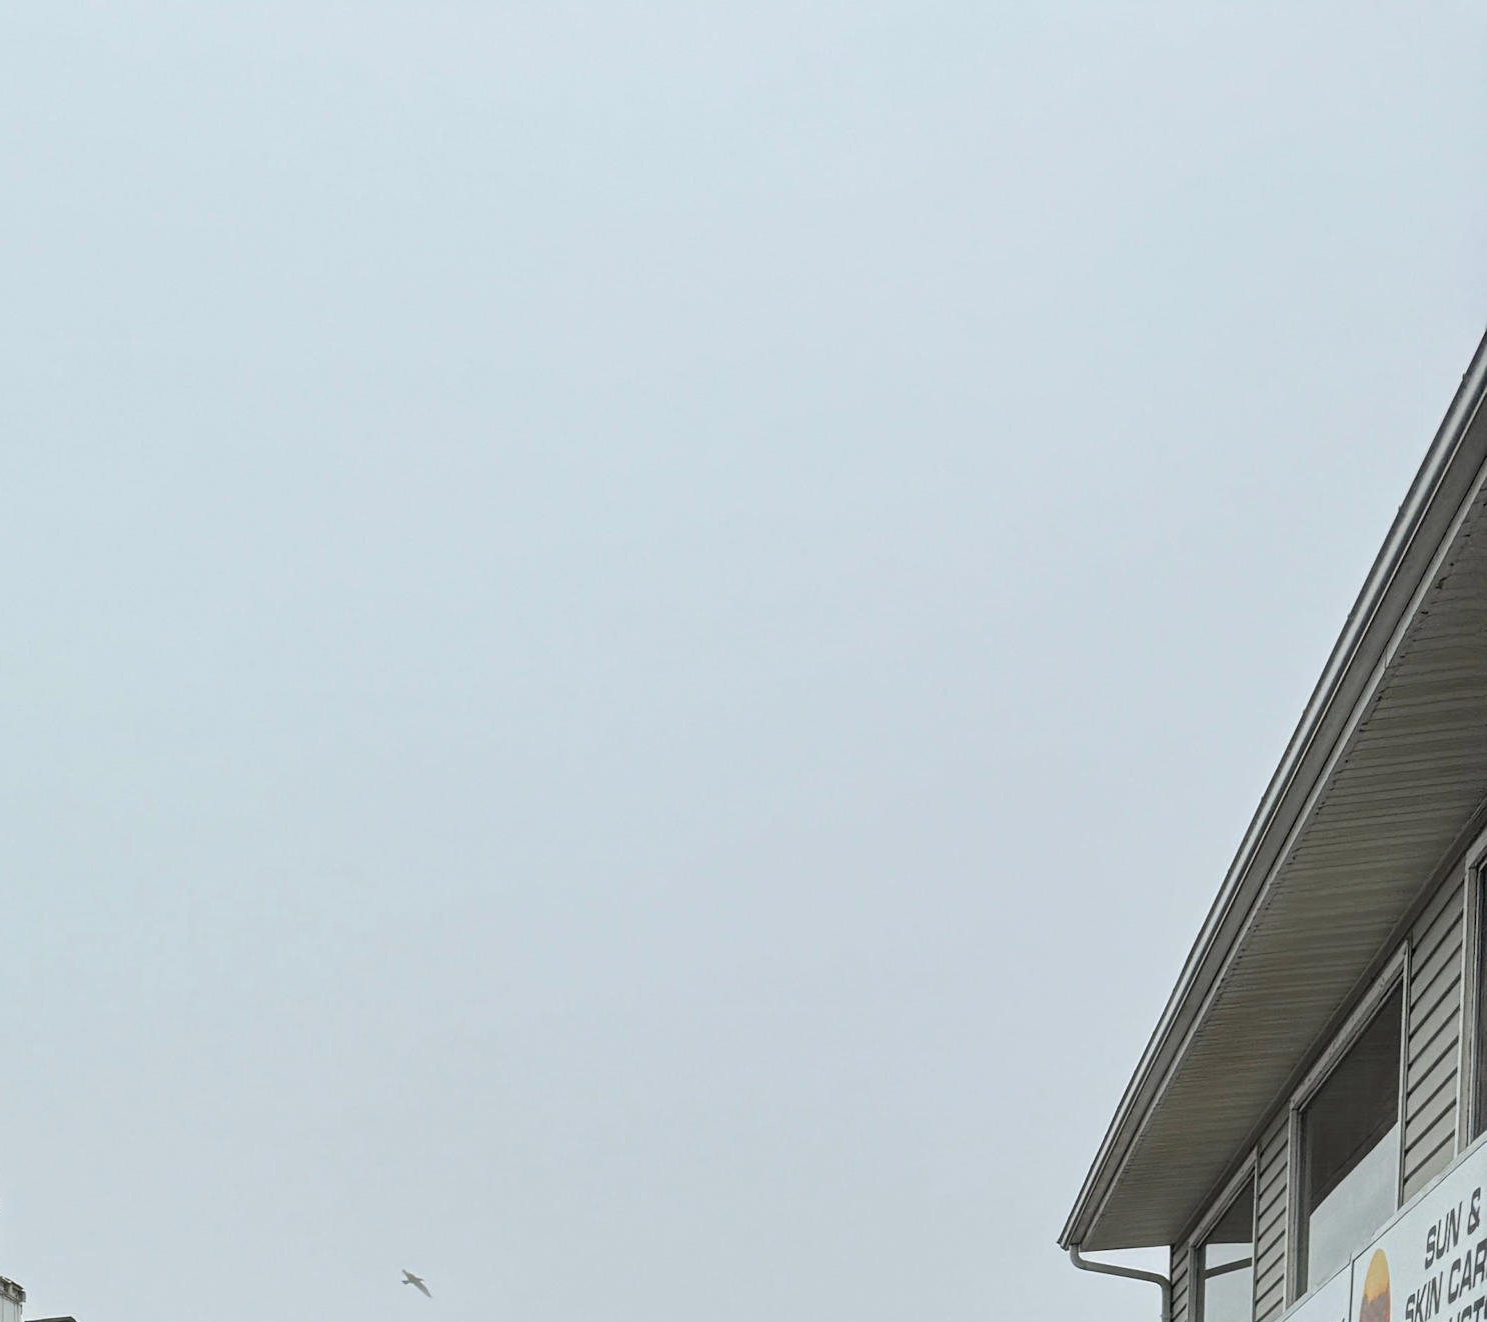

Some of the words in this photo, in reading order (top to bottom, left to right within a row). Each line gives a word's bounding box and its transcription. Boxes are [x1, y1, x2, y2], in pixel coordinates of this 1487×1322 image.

[1425, 1200, 1463, 1269] SUN
[1467, 1186, 1481, 1236] &
[1448, 1238, 1487, 1304] CAR
